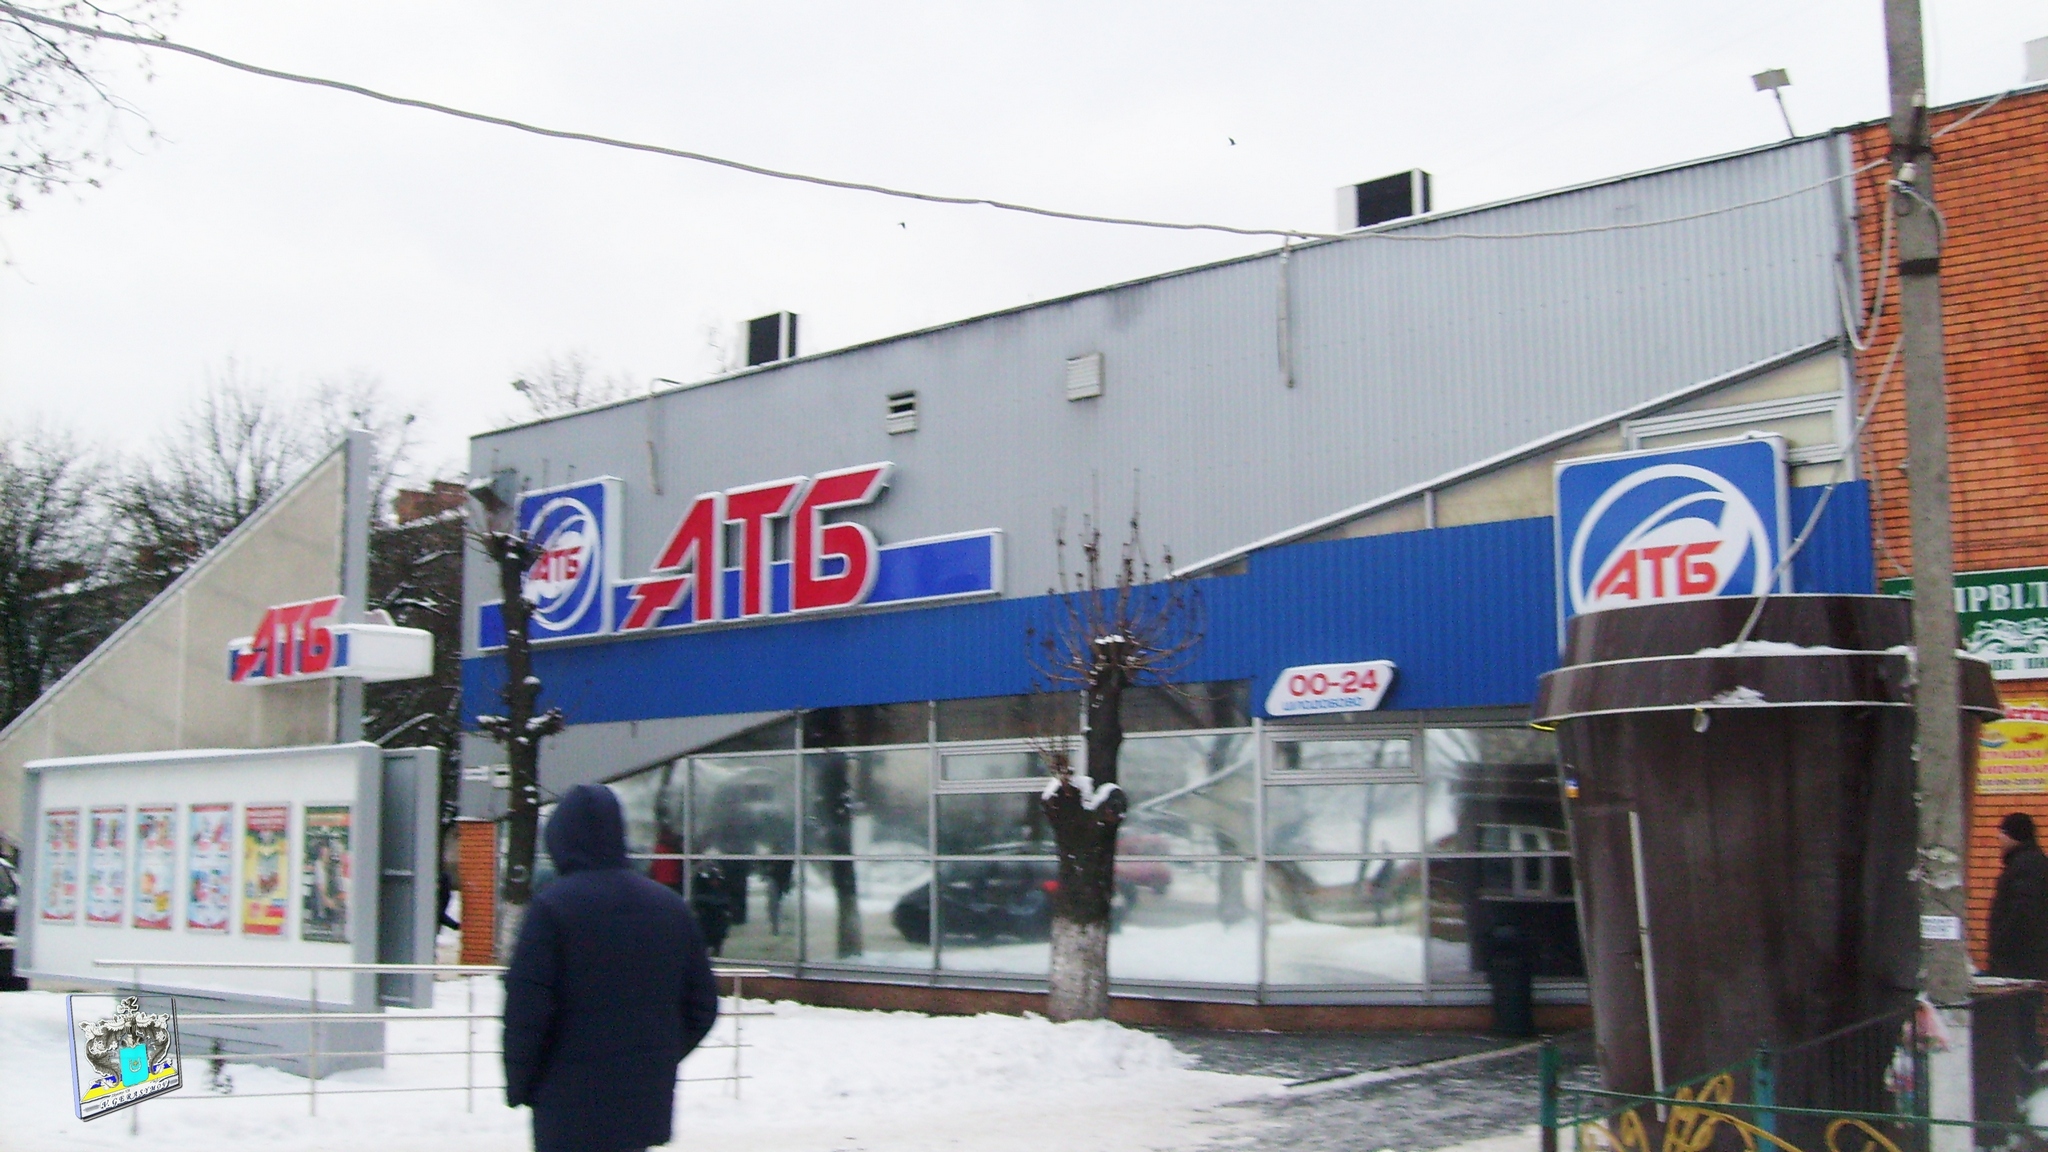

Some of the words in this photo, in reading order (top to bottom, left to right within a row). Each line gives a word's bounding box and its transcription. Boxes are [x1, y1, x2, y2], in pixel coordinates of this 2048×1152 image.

[528, 545, 583, 582] АТБ
[618, 463, 890, 631] АТБ
[1594, 540, 1725, 600] АТБ
[230, 596, 343, 682] АТБ
[1288, 668, 1380, 697] 00-24
